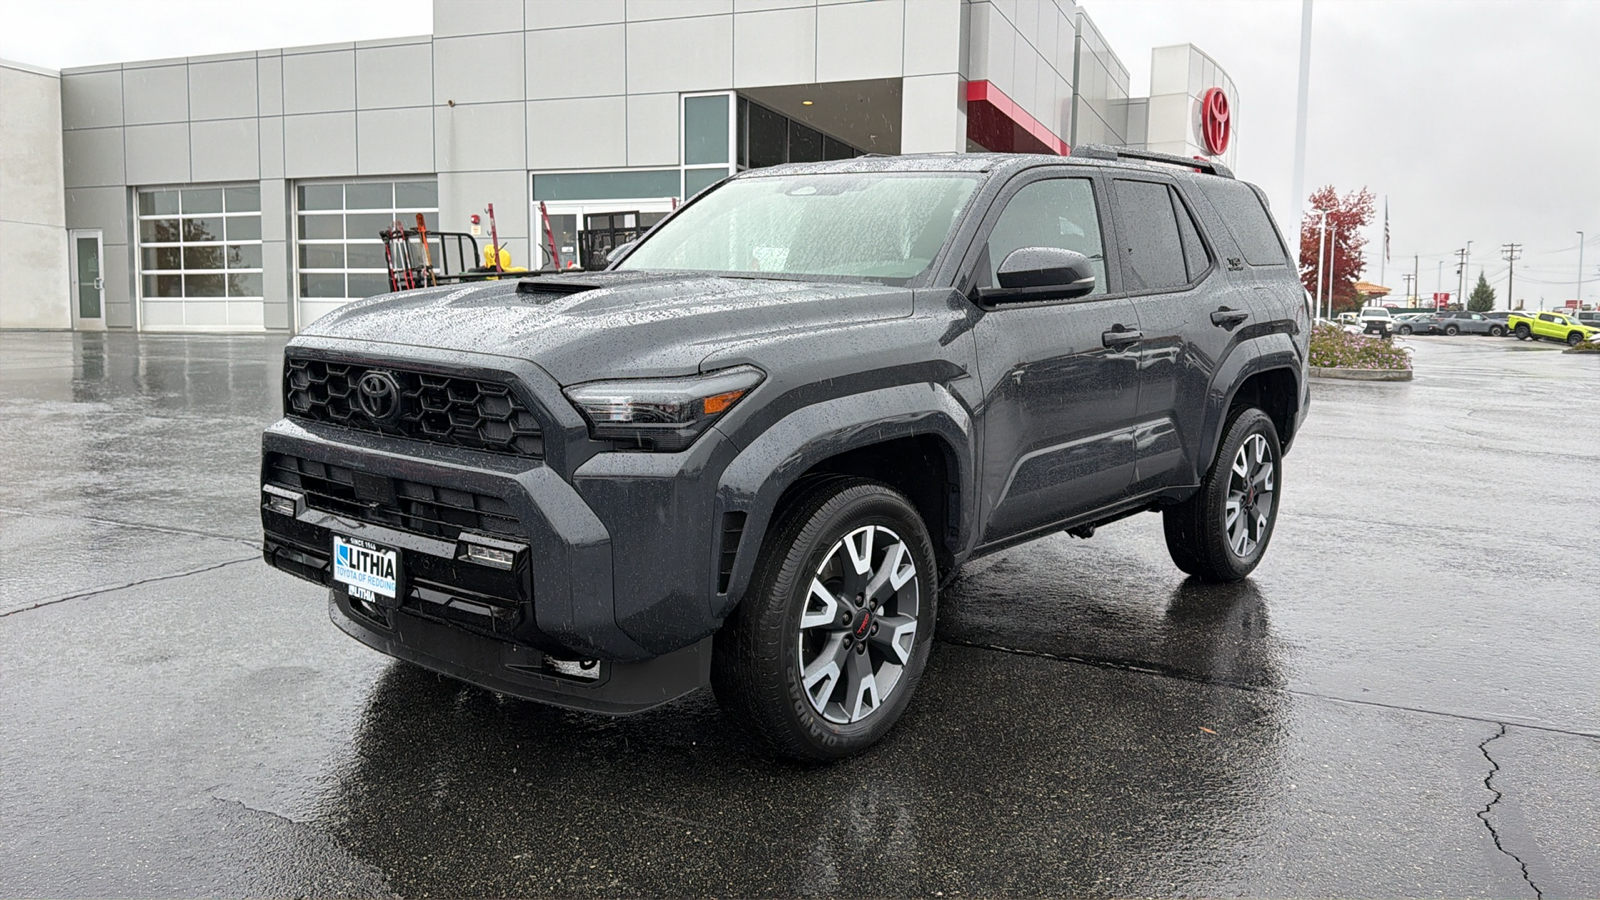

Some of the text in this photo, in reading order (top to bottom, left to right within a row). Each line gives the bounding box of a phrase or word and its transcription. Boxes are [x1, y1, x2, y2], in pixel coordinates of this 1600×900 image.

[350, 548, 394, 580] LITHIA
[337, 566, 395, 592] TOYOTA OF REDDING
[355, 586, 376, 602] LITHIA
